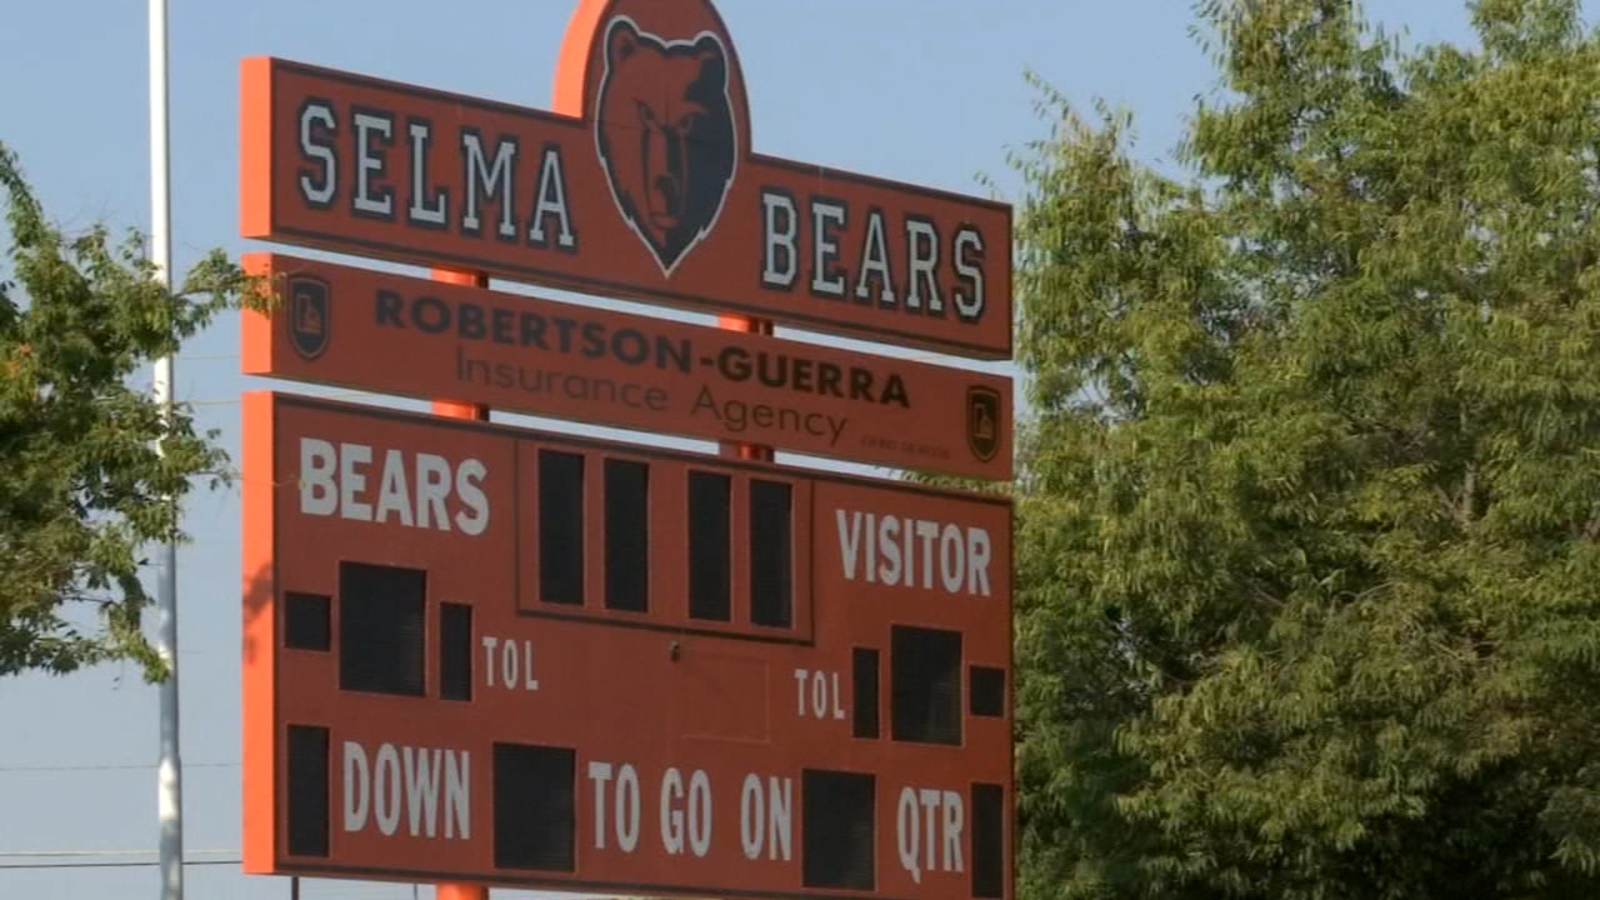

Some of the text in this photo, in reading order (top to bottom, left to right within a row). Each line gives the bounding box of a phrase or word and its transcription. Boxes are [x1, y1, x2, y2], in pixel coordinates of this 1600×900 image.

[299, 102, 576, 248] SELMA
[761, 191, 984, 318] BEARS
[376, 289, 910, 408] ROBERTSON-GUERRA
[456, 346, 848, 446] Insurance Agency
[300, 437, 490, 536] BEARS
[836, 508, 992, 597] VISITOR
[482, 636, 539, 691] TOL
[795, 668, 846, 720] TOL
[343, 740, 470, 840] DOWN
[588, 760, 792, 861] TO GO ON
[897, 786, 964, 883] QTR
